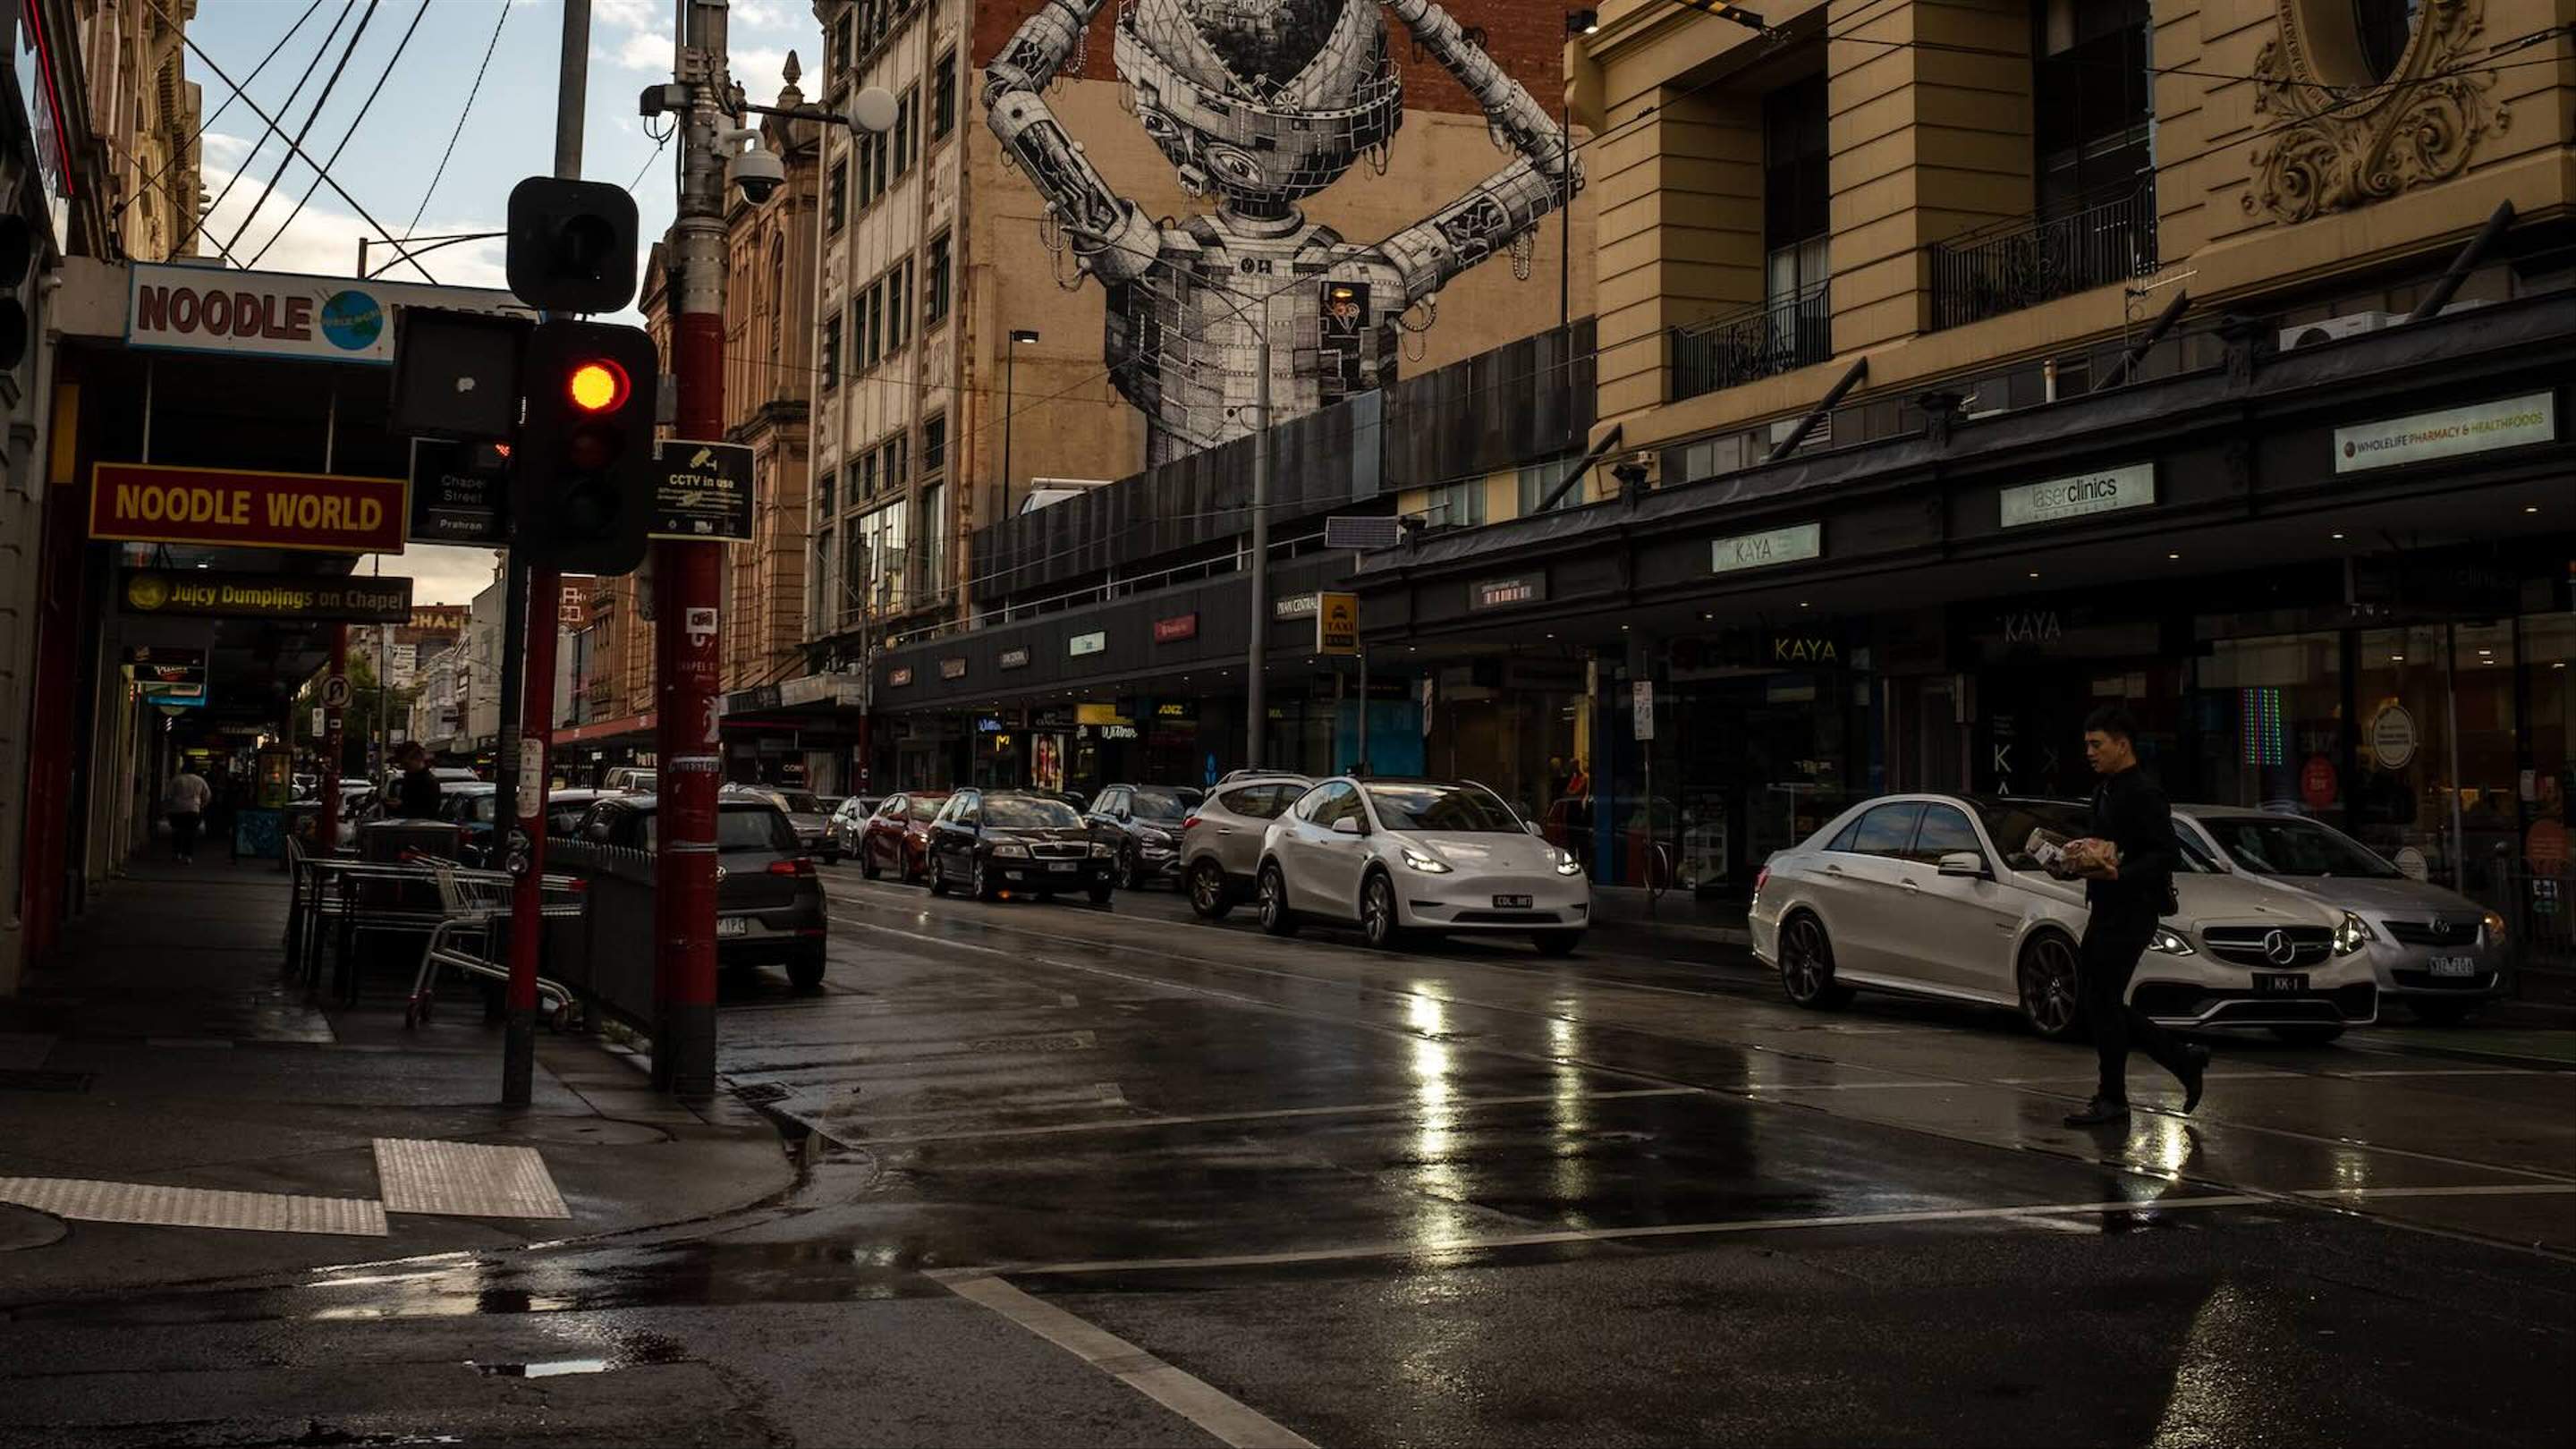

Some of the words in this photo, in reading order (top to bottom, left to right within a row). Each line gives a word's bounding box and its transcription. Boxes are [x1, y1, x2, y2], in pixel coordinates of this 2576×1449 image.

[140, 285, 312, 342] NOODLE
[2357, 435, 2408, 453] WHOLELIFE
[2409, 426, 2460, 445] PHARMACY
[2462, 425, 2470, 436] &
[2471, 411, 2545, 435] HEALTHFOODS
[669, 473, 700, 486] CCTV
[702, 475, 715, 487] in
[115, 484, 251, 526] NOODLE
[267, 493, 384, 531] WORLD
[443, 489, 483, 504] Street
[439, 518, 483, 531] Prahran
[1735, 538, 1773, 564] KAYA
[171, 584, 216, 606] Juicy
[223, 584, 313, 611] Dumplings
[319, 593, 343, 607] on
[346, 589, 402, 613] Chapel
[1327, 621, 1354, 631] TAXI
[2004, 610, 2062, 643] KAYA
[1775, 638, 1838, 663] KAYA
